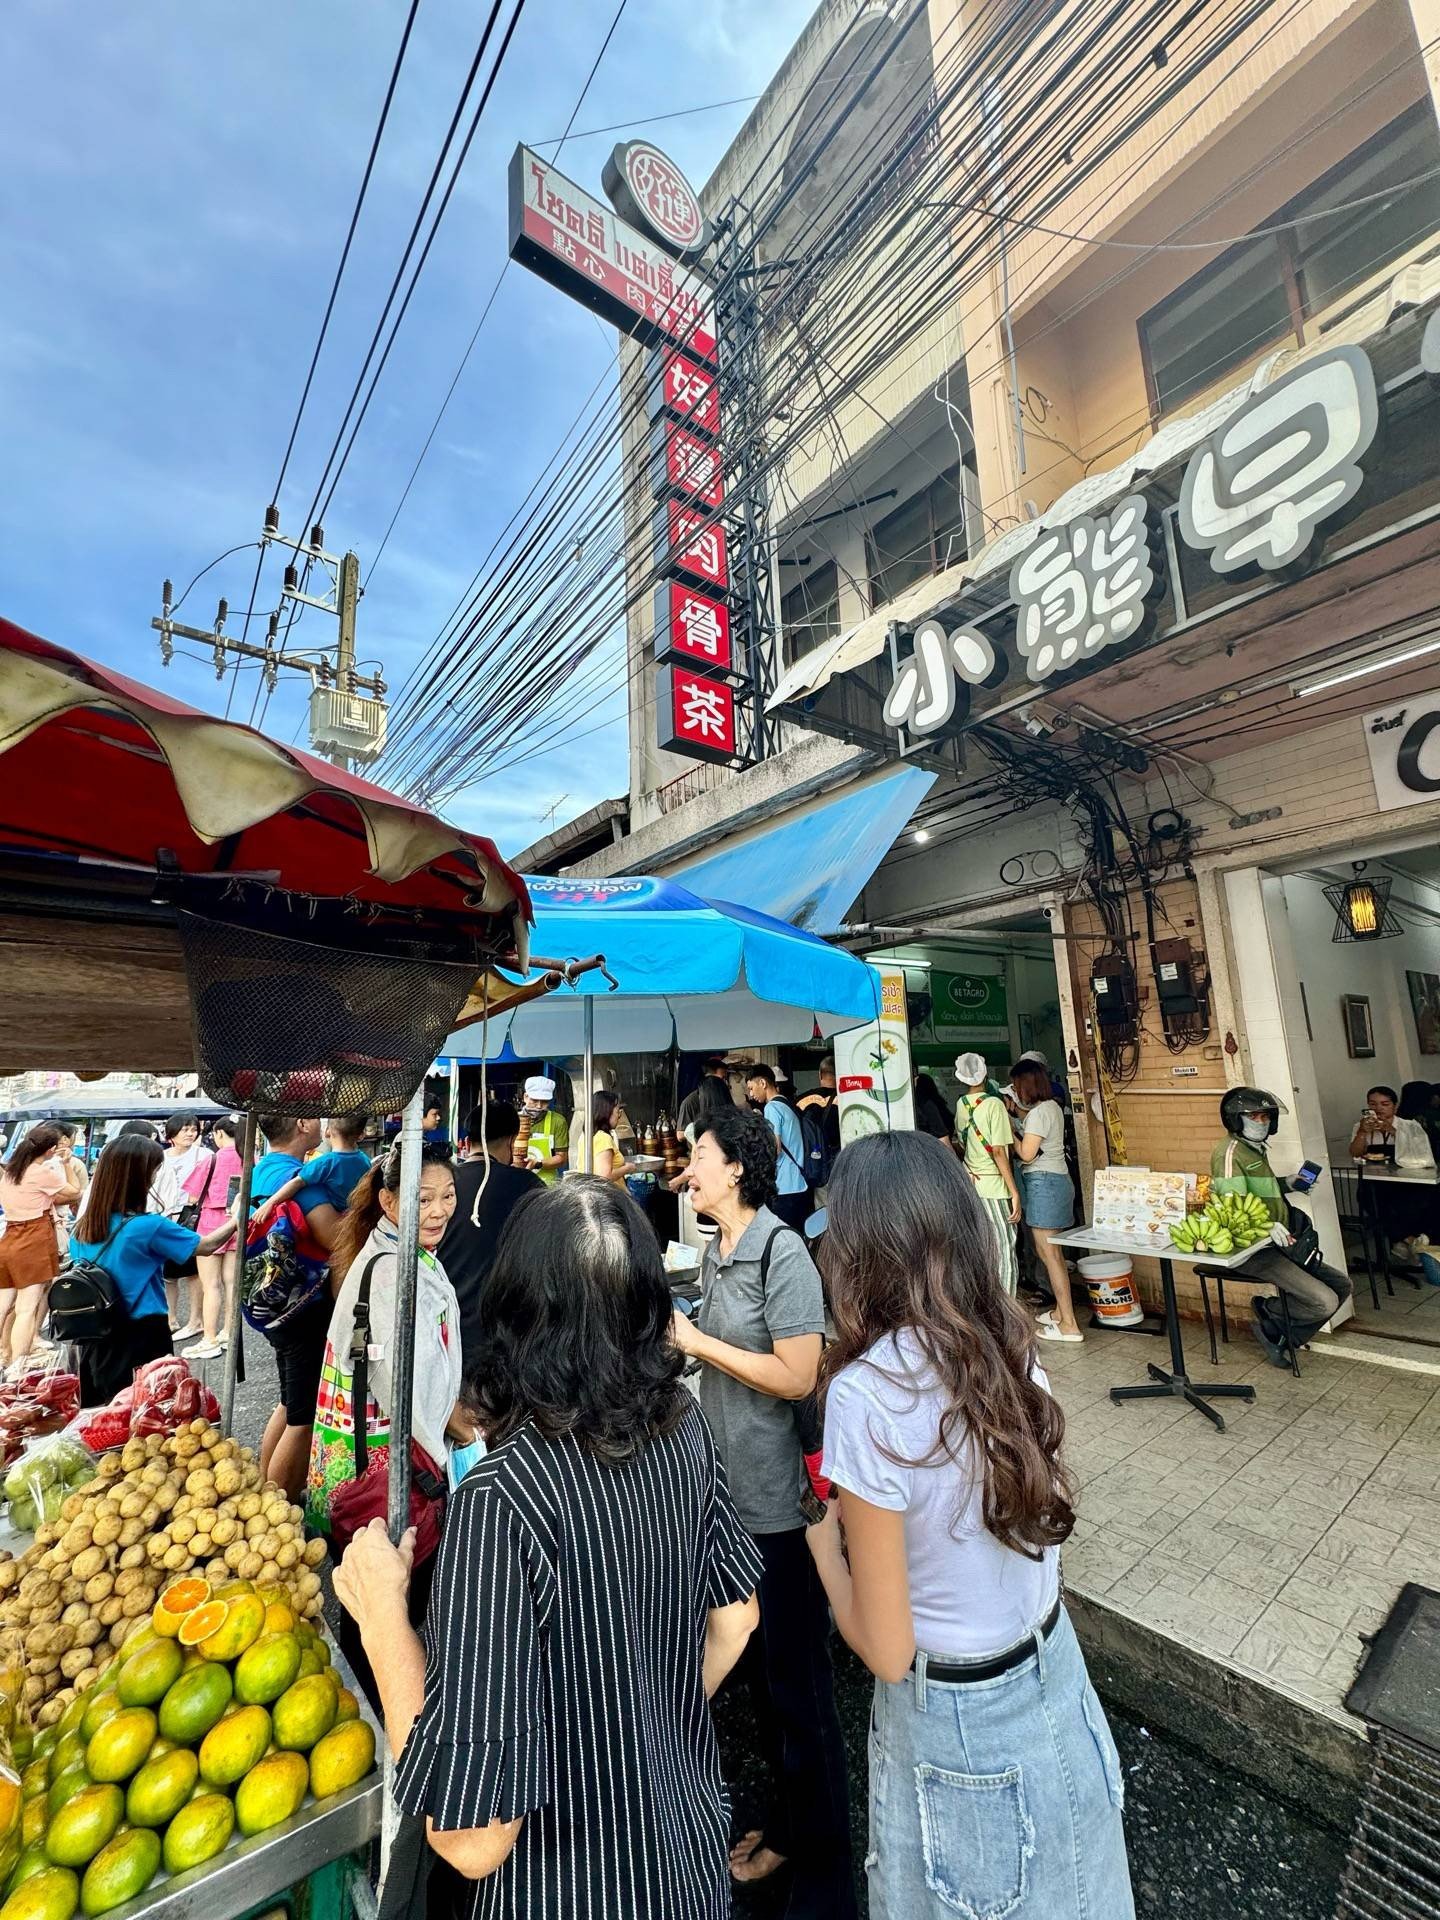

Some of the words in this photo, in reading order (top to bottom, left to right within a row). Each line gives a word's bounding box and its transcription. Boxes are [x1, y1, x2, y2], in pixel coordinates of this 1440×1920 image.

[531, 161, 607, 255] โชคดี
[552, 229, 607, 280] 點心
[883, 300, 1440, 734] 小熊早
